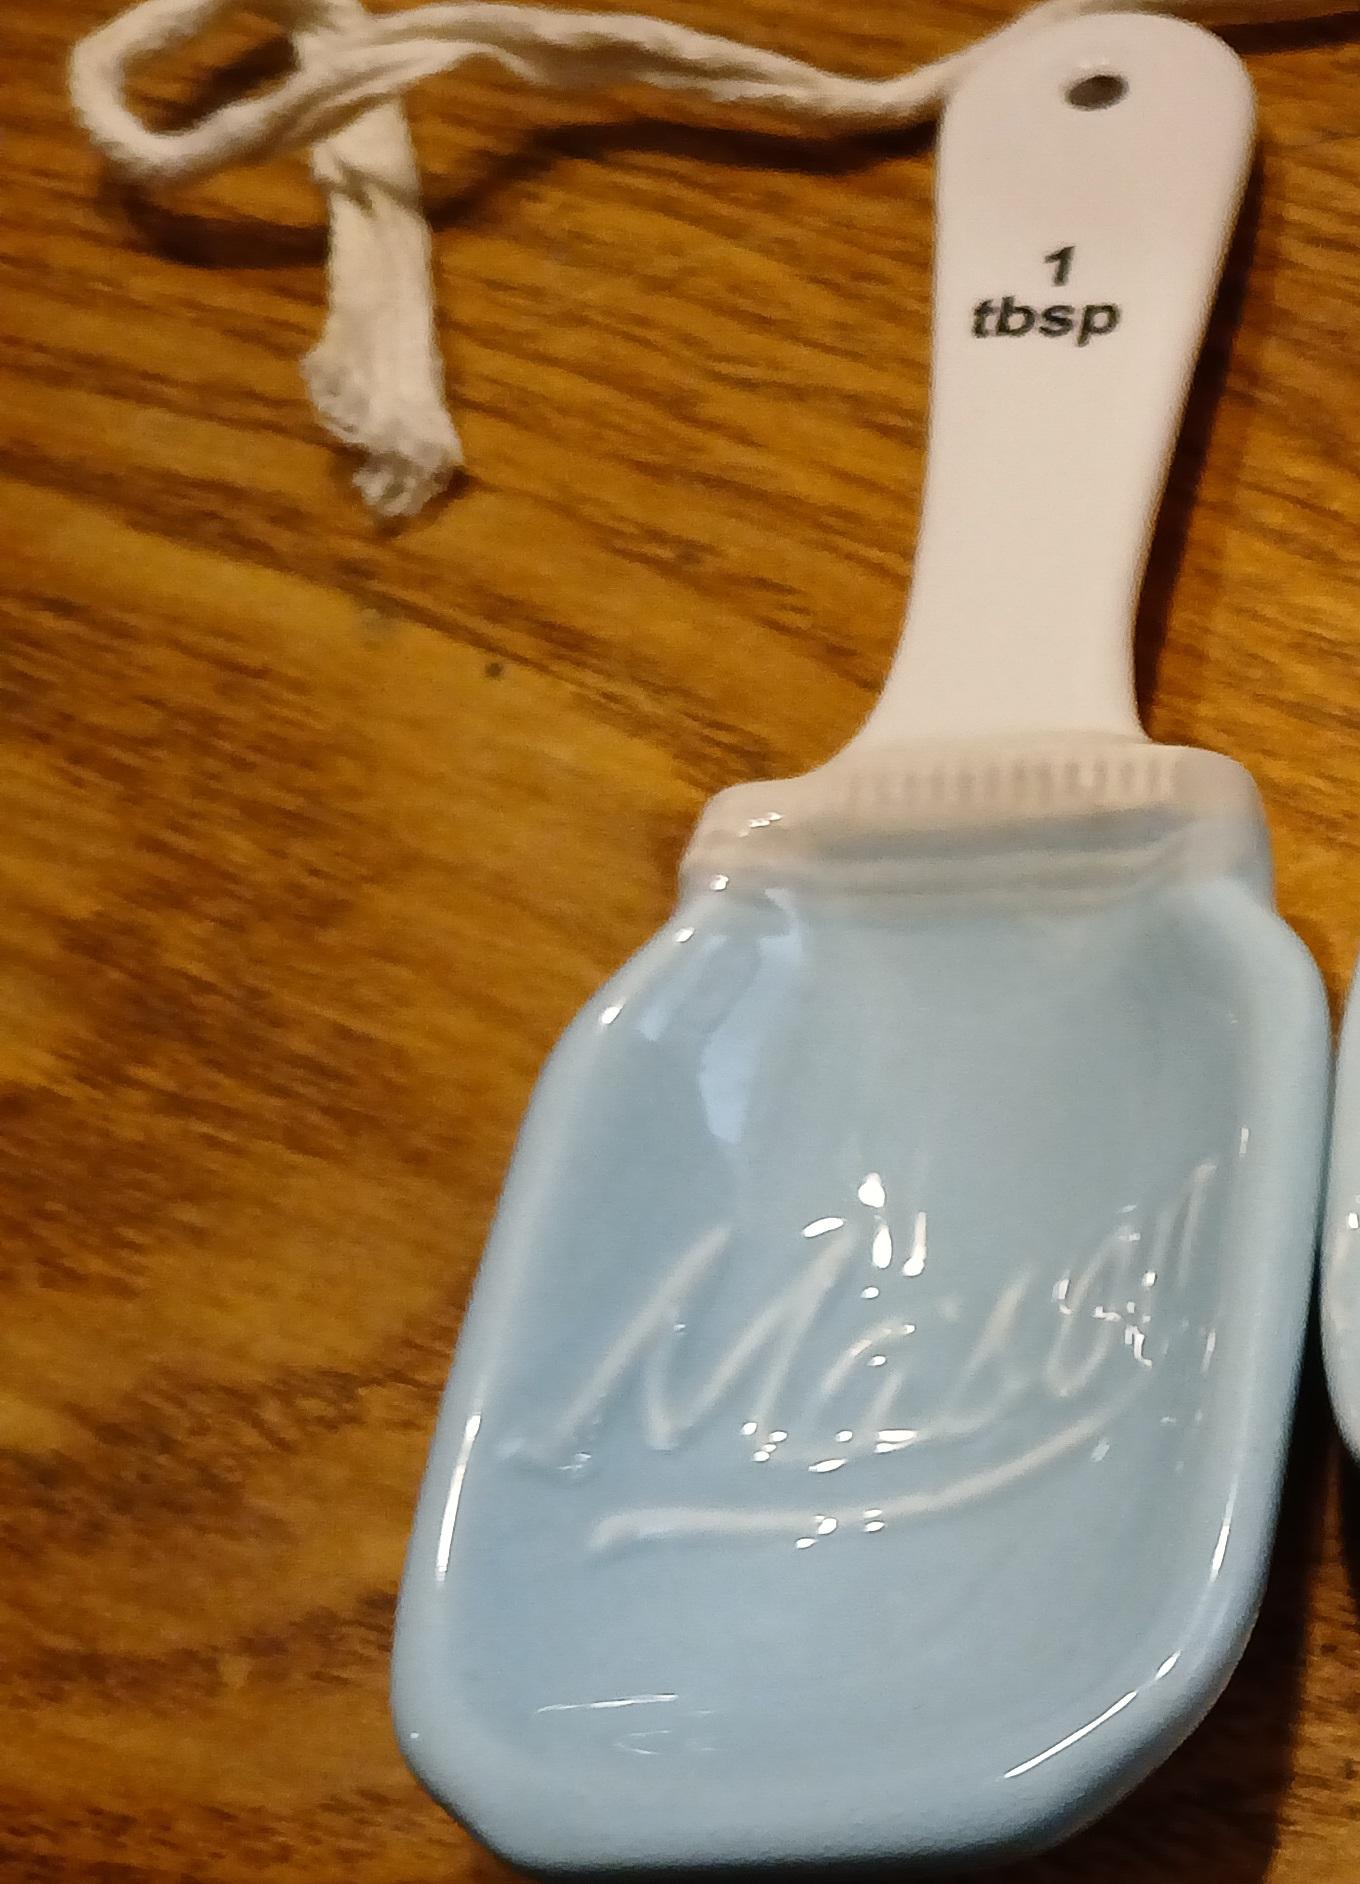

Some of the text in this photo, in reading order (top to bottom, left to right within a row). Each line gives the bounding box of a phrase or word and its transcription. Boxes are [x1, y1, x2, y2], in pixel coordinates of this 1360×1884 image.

[1043, 243, 1077, 288] 1
[970, 294, 1122, 349] tbsp
[510, 1162, 1215, 1465] Mason
